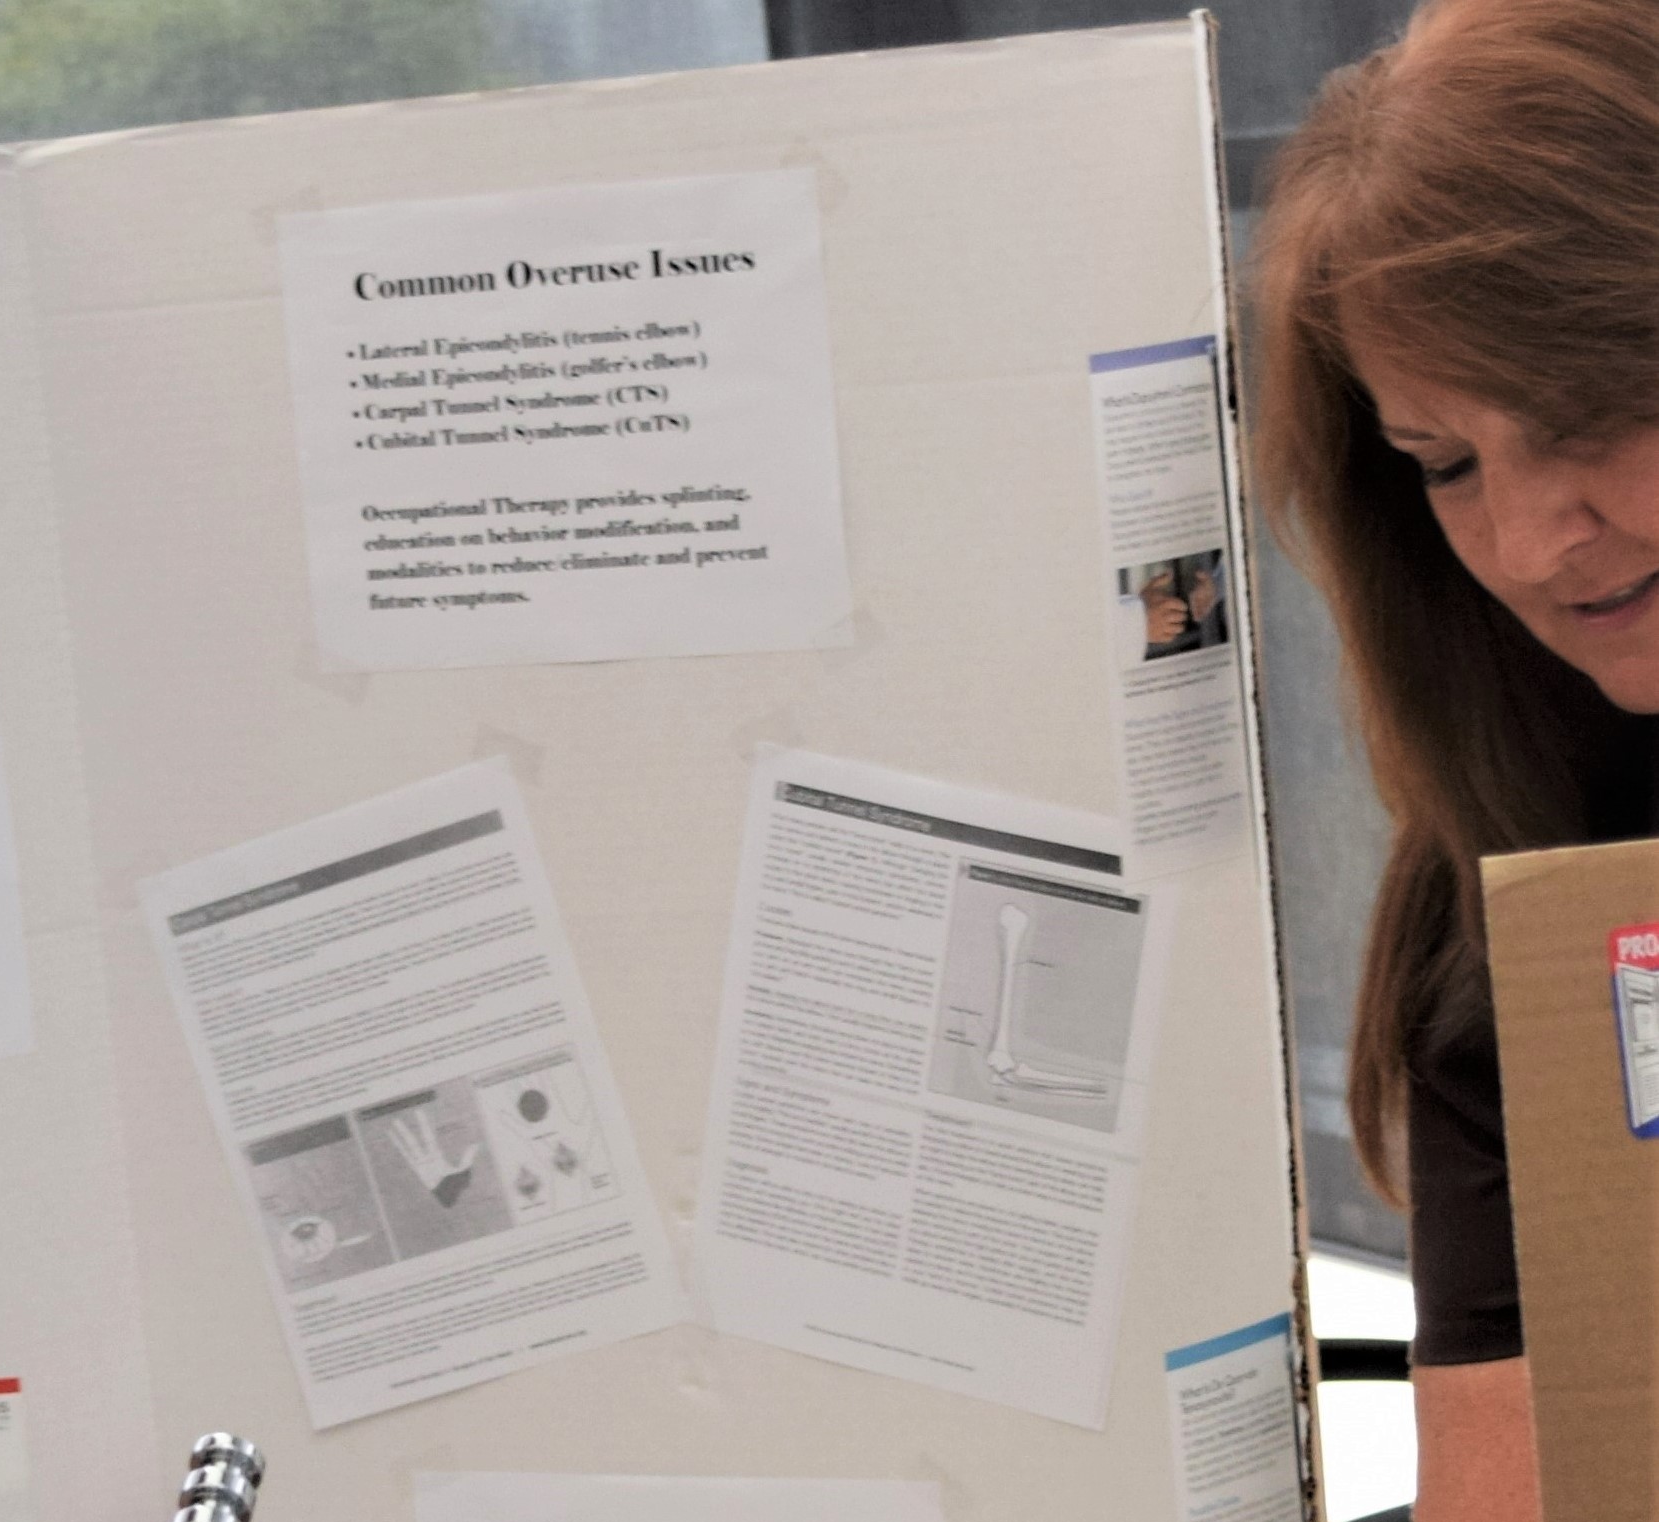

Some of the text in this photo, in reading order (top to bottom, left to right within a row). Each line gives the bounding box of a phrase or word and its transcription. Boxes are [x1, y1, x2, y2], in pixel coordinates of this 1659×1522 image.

[354, 248, 755, 300] Common Overuse Issues
[359, 320, 702, 361] Lateral Epicondylitis (tennis elbow)
[361, 370, 426, 390] Medial
[432, 362, 556, 387] Epicondylitis
[643, 350, 709, 371] elbow)
[364, 385, 669, 423] Carpal Tunnel Syndrome (CTS)
[367, 431, 436, 451] Cubital
[443, 425, 509, 446] Tunnel
[514, 420, 611, 445] Syndrome
[361, 500, 488, 524] Occupational
[493, 496, 568, 516] Therapy
[575, 490, 656, 514] provides
[363, 532, 456, 552] education
[460, 532, 484, 547] on
[488, 525, 568, 545] behavior
[704, 514, 740, 533] and
[367, 560, 464, 581] modalities
[468, 560, 488, 577] to
[655, 546, 691, 566] and
[695, 544, 770, 568] prevent
[369, 592, 427, 611] future
